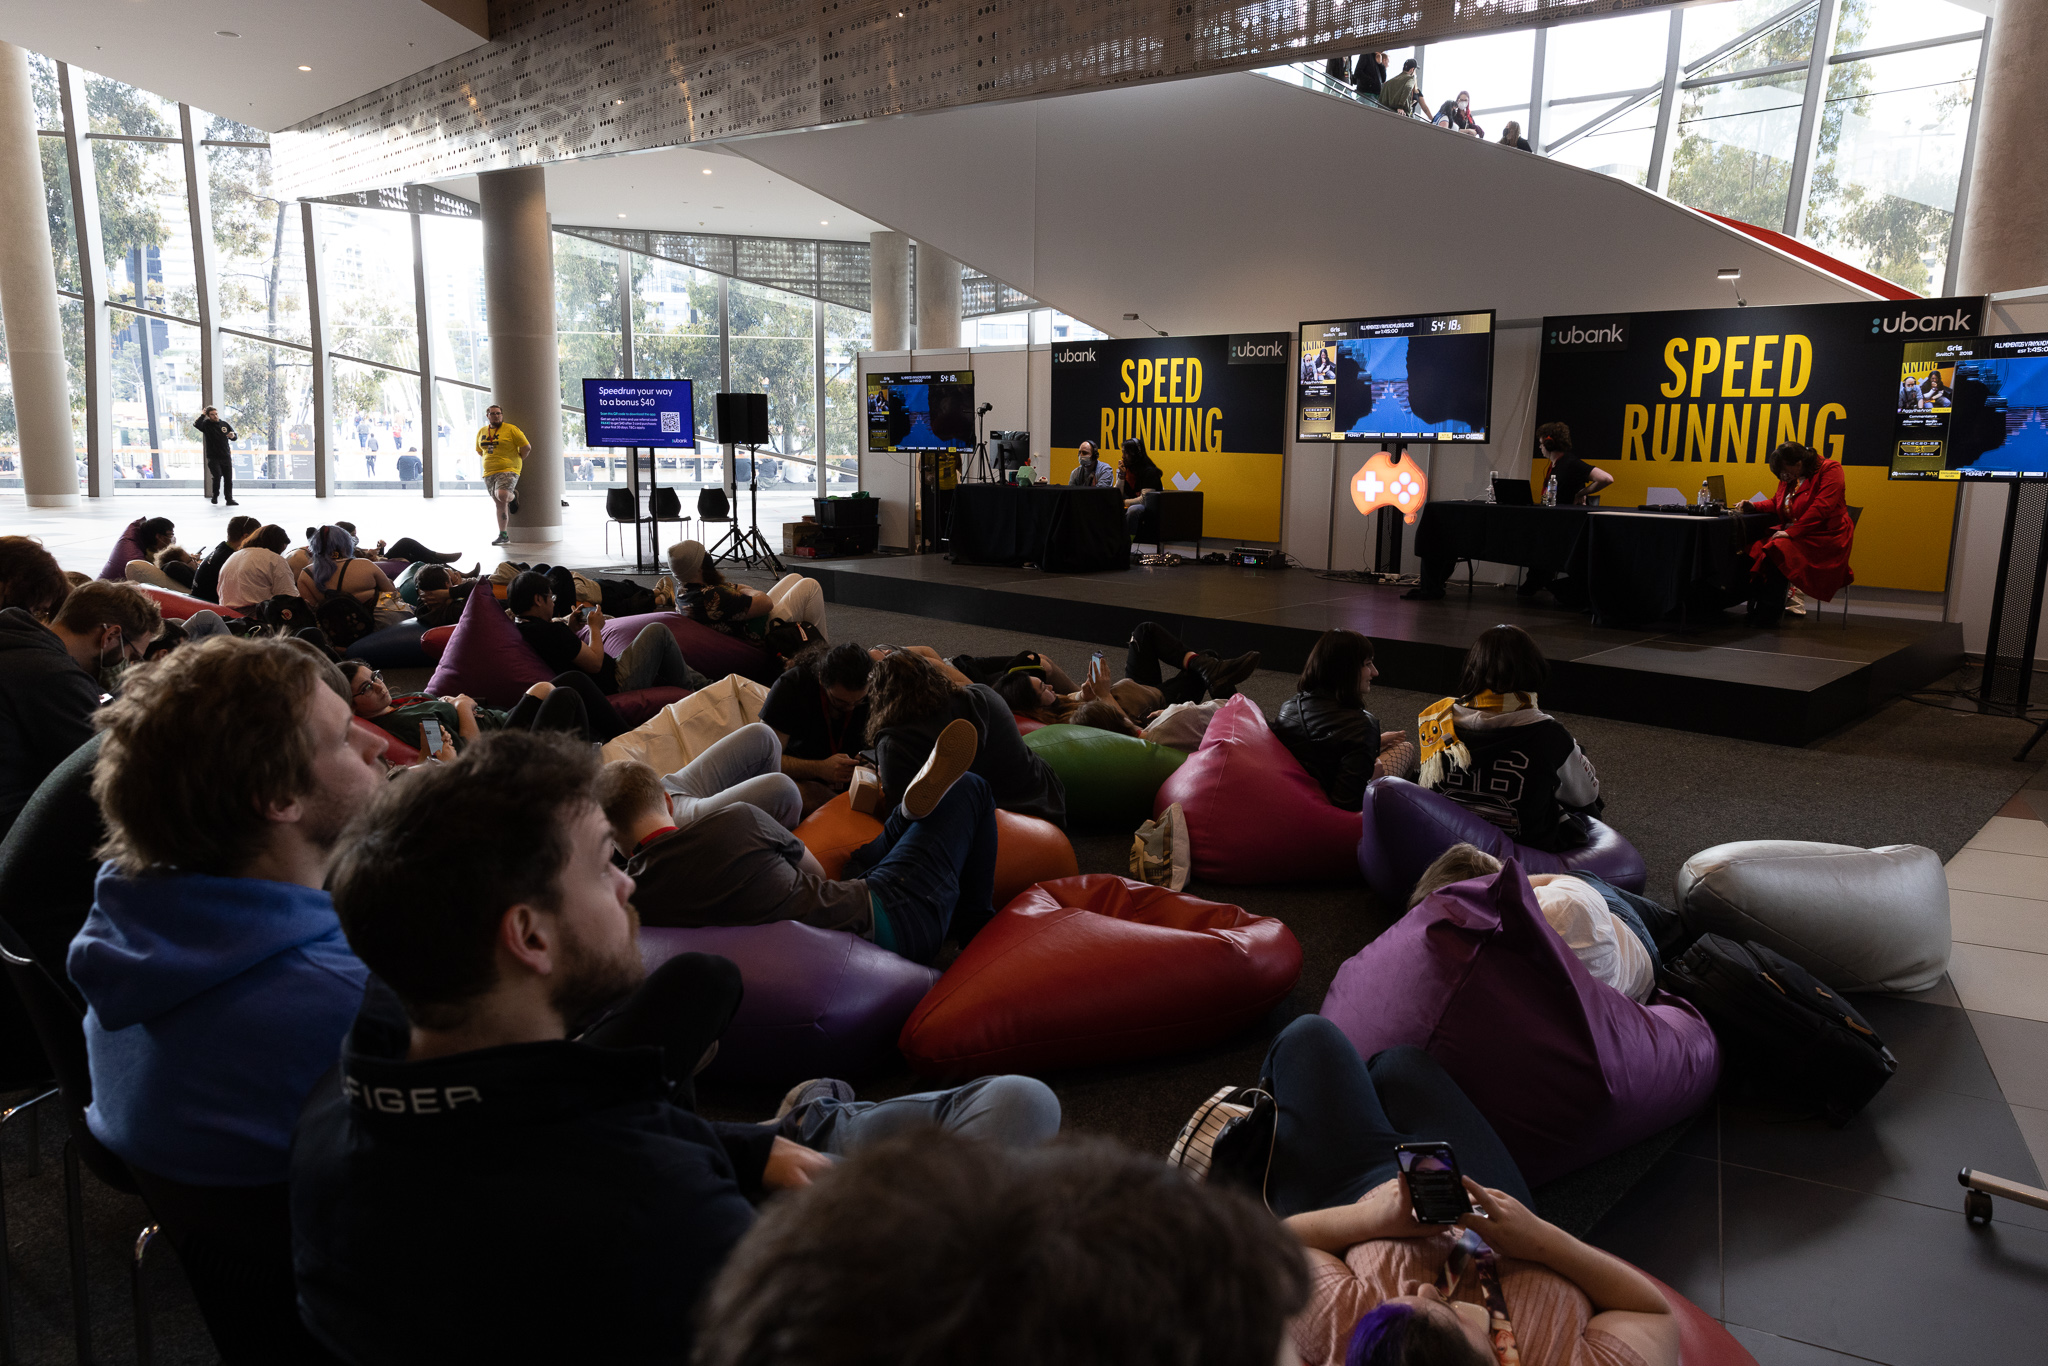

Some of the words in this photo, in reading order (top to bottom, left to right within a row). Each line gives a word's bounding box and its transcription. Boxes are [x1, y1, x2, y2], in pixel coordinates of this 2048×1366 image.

[1883, 308, 1971, 333] ubank
[1558, 323, 1624, 345] ubank
[1058, 347, 1097, 363] ubank
[1237, 341, 1283, 357] ubank
[1659, 333, 1814, 399] SPEED
[598, 386, 636, 397] Speedrun
[637, 388, 654, 397] your
[655, 389, 673, 397] way
[1119, 357, 1203, 404] SPEED
[599, 398, 608, 406] to
[615, 398, 639, 406] bonus
[640, 397, 656, 407] $40
[1100, 407, 1223, 453] RUNNING
[1620, 402, 1848, 466] RUNNING
